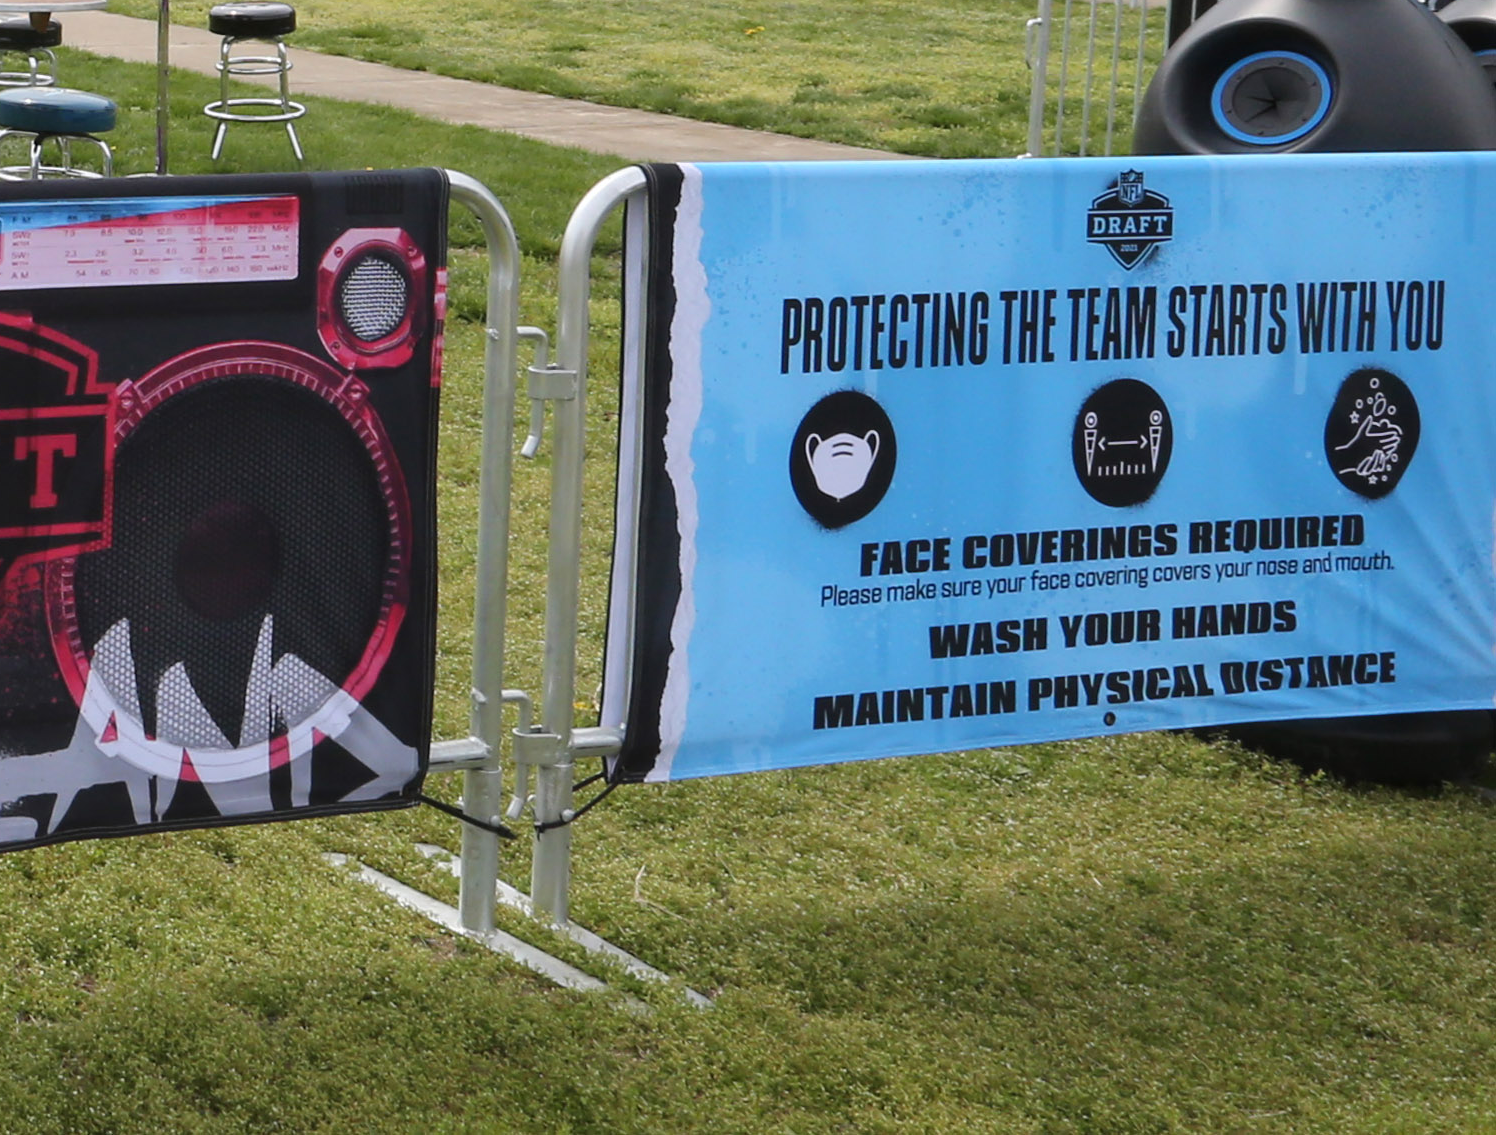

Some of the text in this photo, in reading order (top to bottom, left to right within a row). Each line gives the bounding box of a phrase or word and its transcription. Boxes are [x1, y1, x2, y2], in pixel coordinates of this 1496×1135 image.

[1120, 183, 1142, 201] NFL
[1092, 215, 1168, 235] DRAFT
[780, 279, 1446, 375] PROTECTING THE TEAM STARTS WITH YOU
[860, 513, 1366, 578] FACE COVERINGS REQUIRED
[821, 551, 1395, 608] Please make sure your face covering covers your nose and mouth.
[929, 600, 1297, 659] WASH YOUR HANDS
[813, 652, 1397, 731] MAINTAIN PHYSICAL DISTANCE
